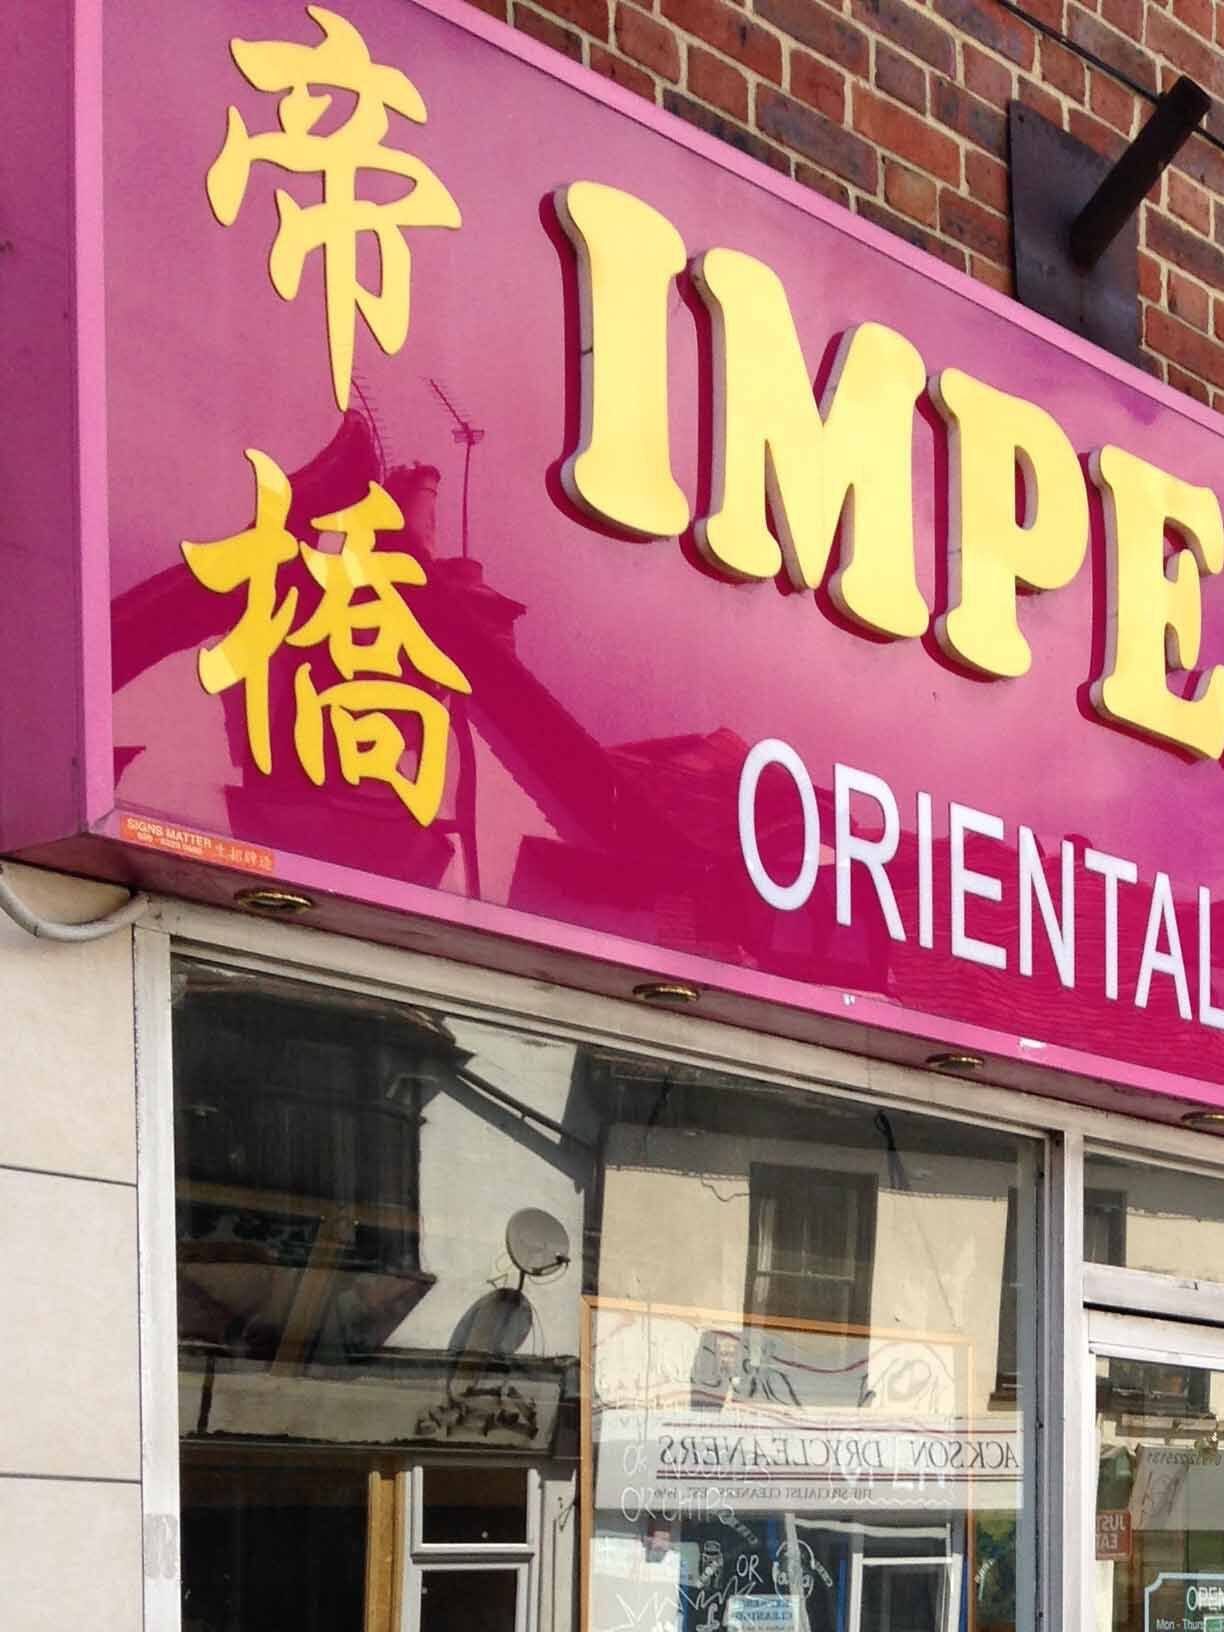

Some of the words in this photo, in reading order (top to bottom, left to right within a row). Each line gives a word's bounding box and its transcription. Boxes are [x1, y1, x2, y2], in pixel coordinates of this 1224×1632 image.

[127, 817, 164, 837] SIGNS
[165, 827, 212, 849] MATTER
[735, 1553, 764, 1584] OR
